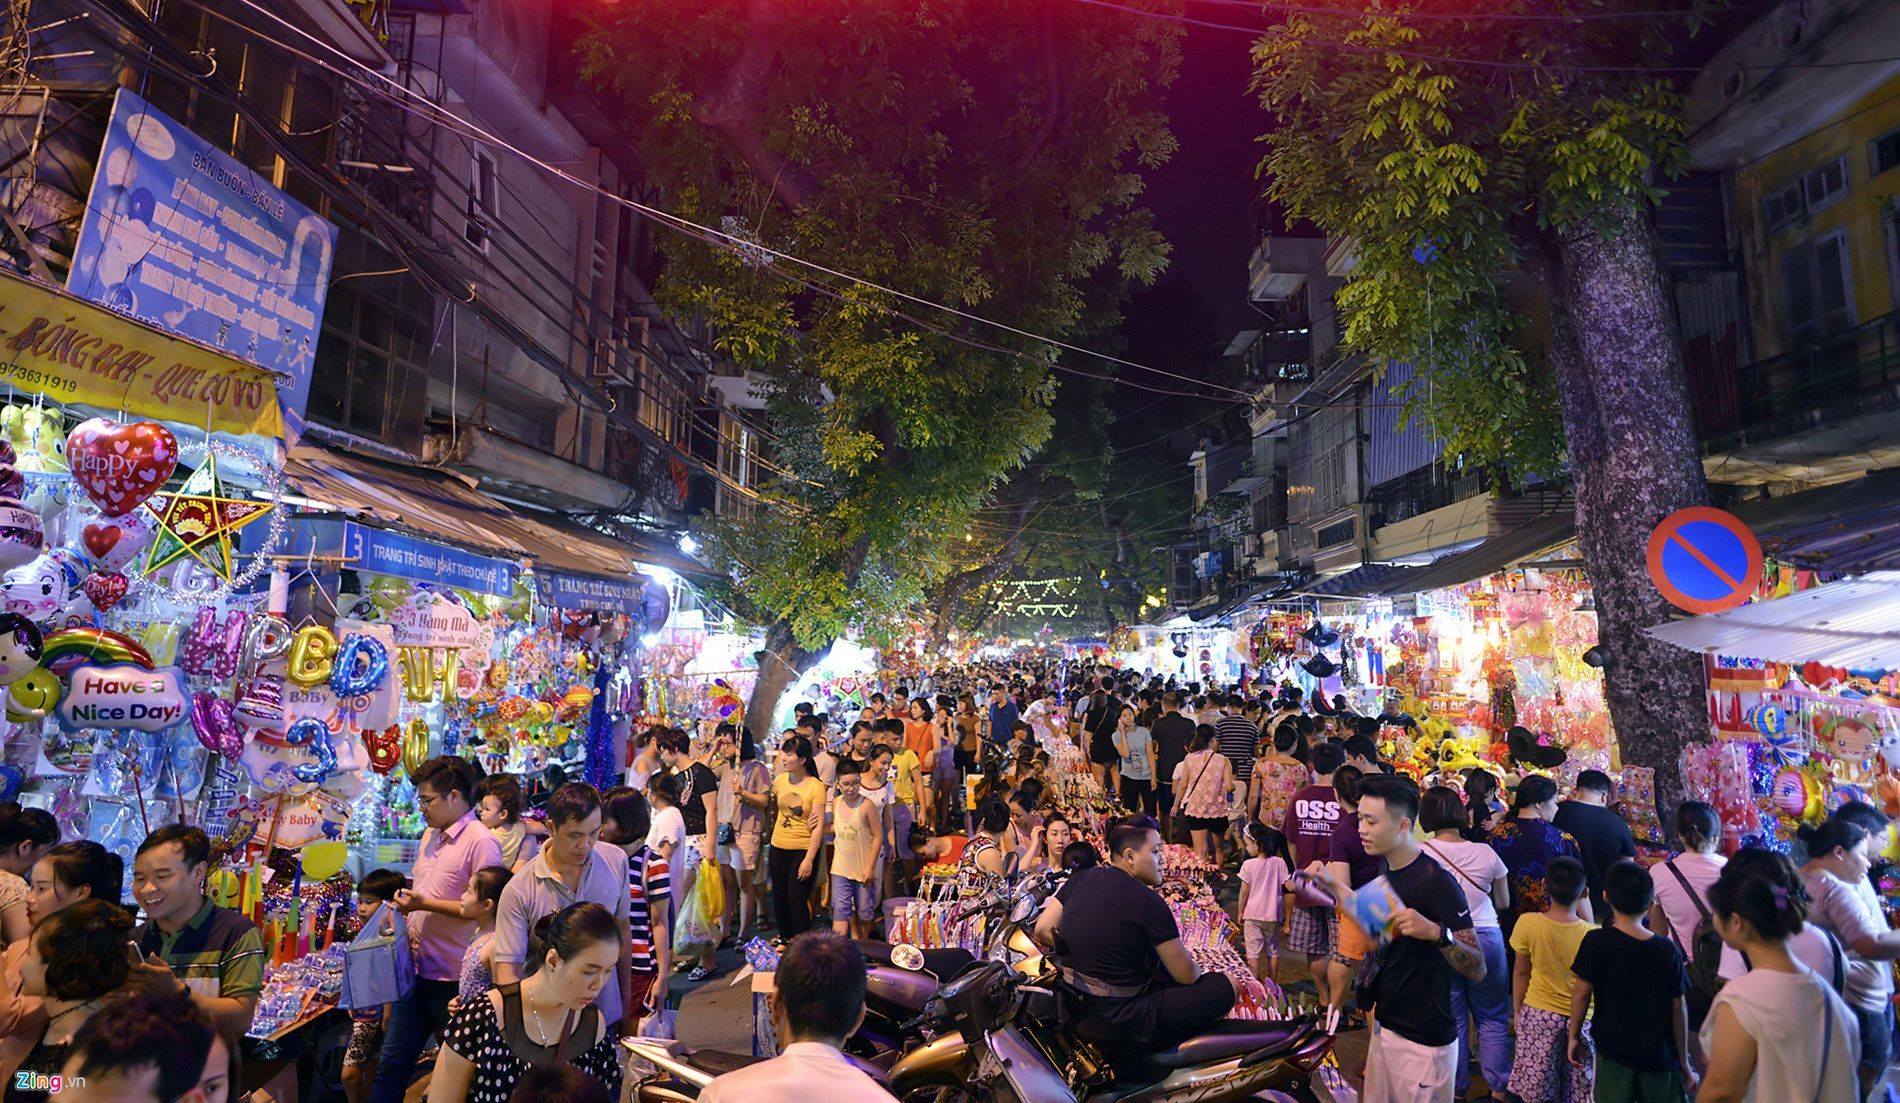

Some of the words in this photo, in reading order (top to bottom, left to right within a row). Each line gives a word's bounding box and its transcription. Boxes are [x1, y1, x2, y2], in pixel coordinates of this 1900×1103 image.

[192, 151, 216, 178] BÁN
[217, 169, 247, 197] BUÔN
[251, 188, 272, 212] BÁN
[6, 316, 103, 370] BÓNG
[150, 363, 207, 405] QUE
[70, 447, 139, 480] Happy
[352, 533, 363, 561] 3
[373, 543, 403, 563] TRANG
[403, 550, 417, 567] TRÍ
[417, 554, 436, 571] SINH
[457, 562, 475, 578] THEO
[501, 568, 509, 592] 3
[408, 611, 417, 627] 3
[419, 612, 449, 632] Hàng
[84, 677, 147, 695] Have
[149, 680, 165, 694] a
[71, 703, 125, 721] Nice
[129, 700, 182, 723] Day!
[1295, 799, 1341, 821] OSS
[1301, 820, 1331, 831] Health
